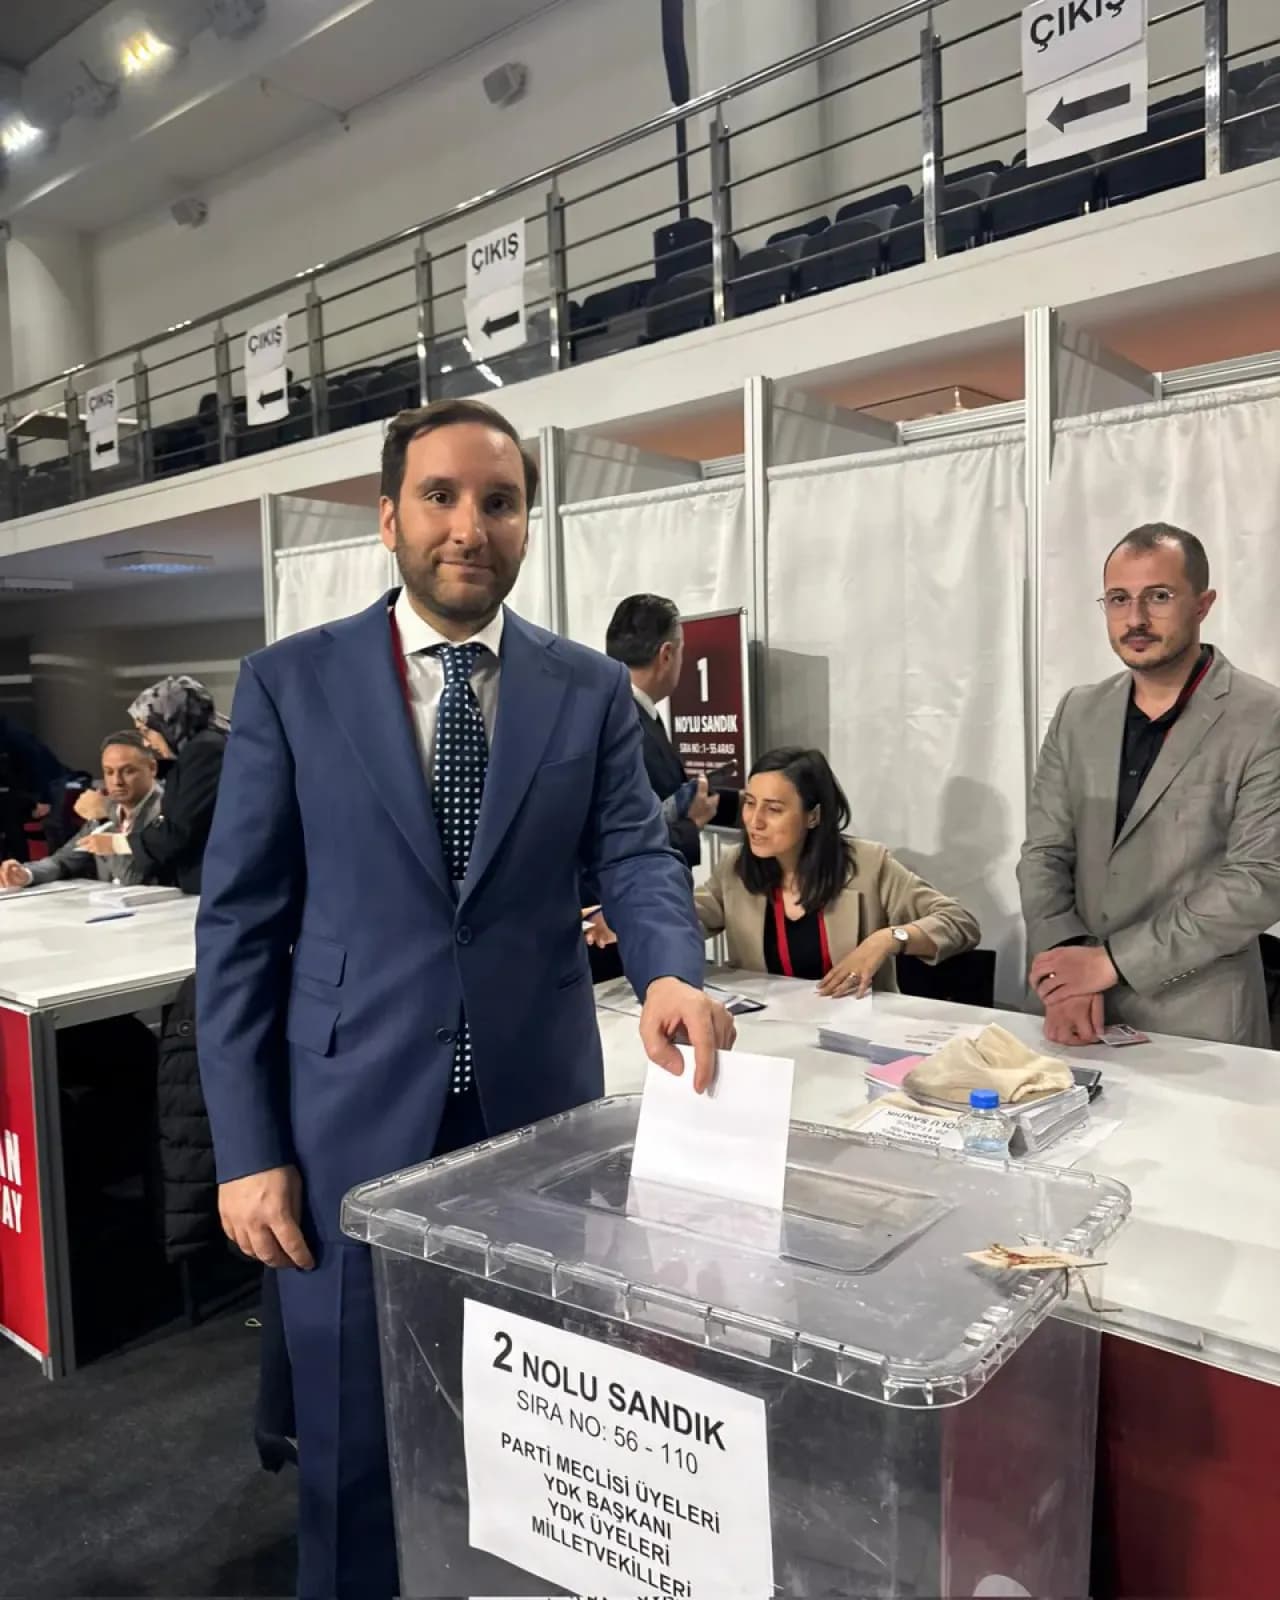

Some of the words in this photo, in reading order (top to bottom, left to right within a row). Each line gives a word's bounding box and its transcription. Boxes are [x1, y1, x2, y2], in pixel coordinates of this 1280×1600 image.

[472, 232, 519, 275] ÇIKIŞ
[248, 325, 282, 357] ÇIKIŞ
[697, 657, 709, 702] 1
[701, 714, 738, 733] SANDIK
[493, 1331, 513, 1373] 2
[523, 1351, 597, 1402] NOLU
[608, 1382, 726, 1451] SANDIK
[516, 1389, 564, 1426] SIRA
[569, 1408, 607, 1442] NO:
[614, 1424, 638, 1452] 56
[660, 1442, 698, 1475] 110
[501, 1431, 551, 1467] PARTİ
[556, 1453, 629, 1497] MECLİSİ
[635, 1479, 721, 1535] ÜYELERİ
[543, 1472, 582, 1503] YDK
[586, 1490, 672, 1541] BAŞKANI
[531, 1515, 692, 1599] MİLLETVEKİLLERİ
[547, 1497, 585, 1529] YDK
[590, 1512, 670, 1567] ÜYELERİ
